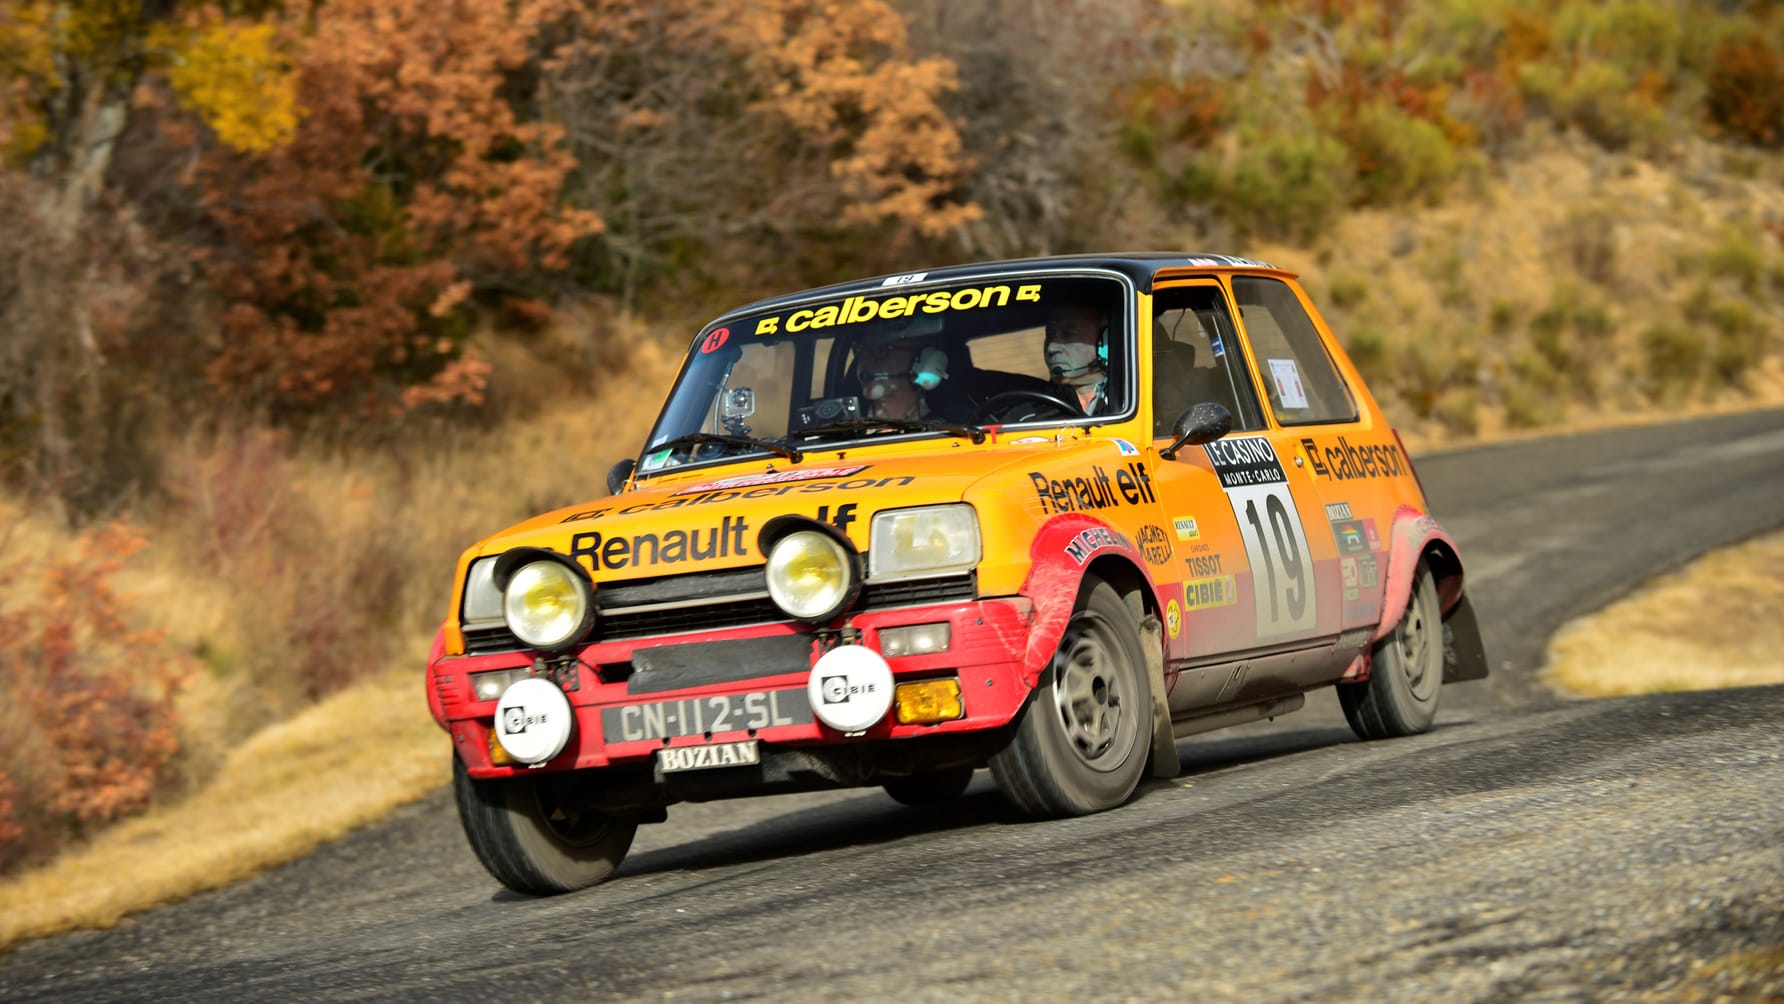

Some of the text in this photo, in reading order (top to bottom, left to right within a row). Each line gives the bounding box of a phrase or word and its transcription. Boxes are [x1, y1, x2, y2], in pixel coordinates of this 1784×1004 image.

[785, 285, 1011, 332] calberson
[710, 332, 721, 349] H
[1204, 438, 1274, 467] LE CASINO
[1325, 436, 1408, 482] calberson
[618, 475, 916, 516] calberson
[1027, 462, 1156, 515] Renault elf
[571, 515, 749, 572] Renault
[1066, 527, 1131, 564] MICHELIN
[1245, 493, 1306, 625] 19
[1185, 553, 1223, 578] TISSOT
[621, 690, 793, 742] CN-112-SL
[661, 742, 758, 772] BOZIAN
